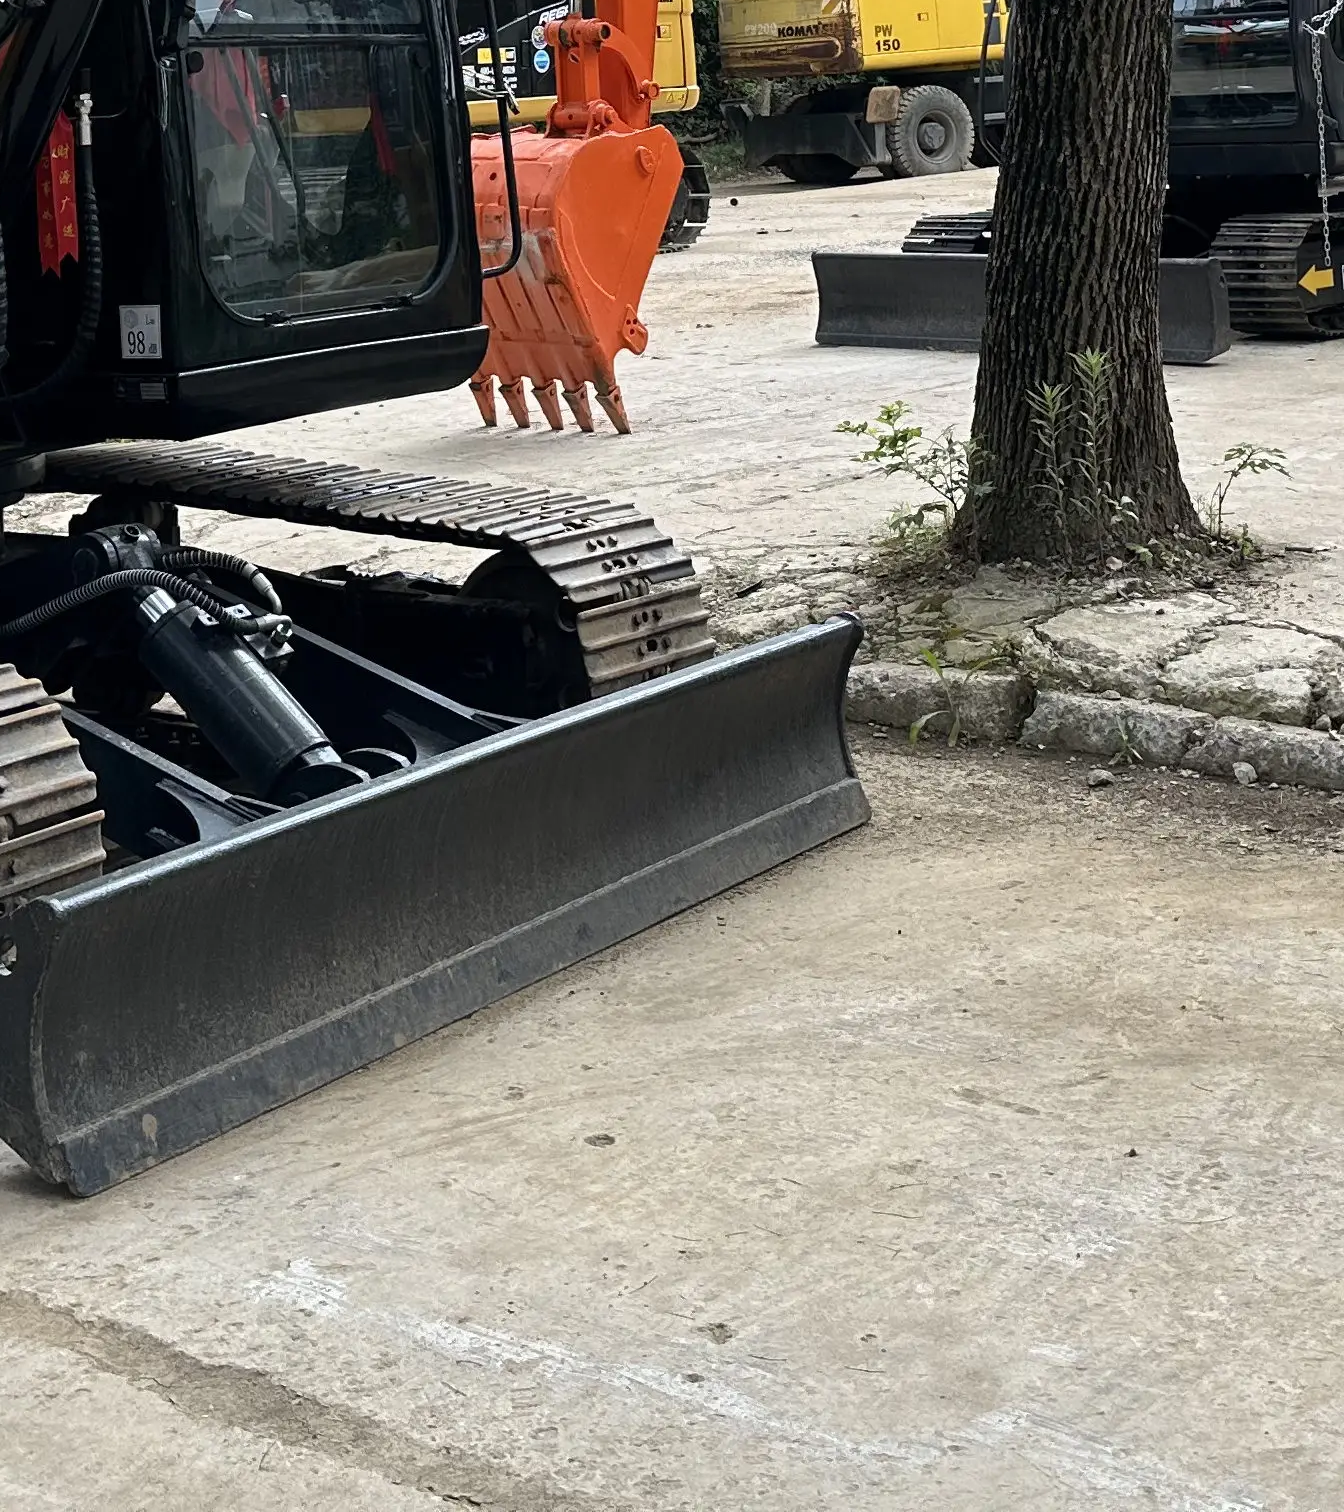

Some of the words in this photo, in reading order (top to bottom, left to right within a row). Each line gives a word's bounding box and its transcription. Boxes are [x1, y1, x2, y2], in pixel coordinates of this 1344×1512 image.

[874, 24, 893, 37] PW
[875, 38, 901, 53] 150
[57, 143, 76, 238] 财源广进
[127, 330, 146, 355] 98
